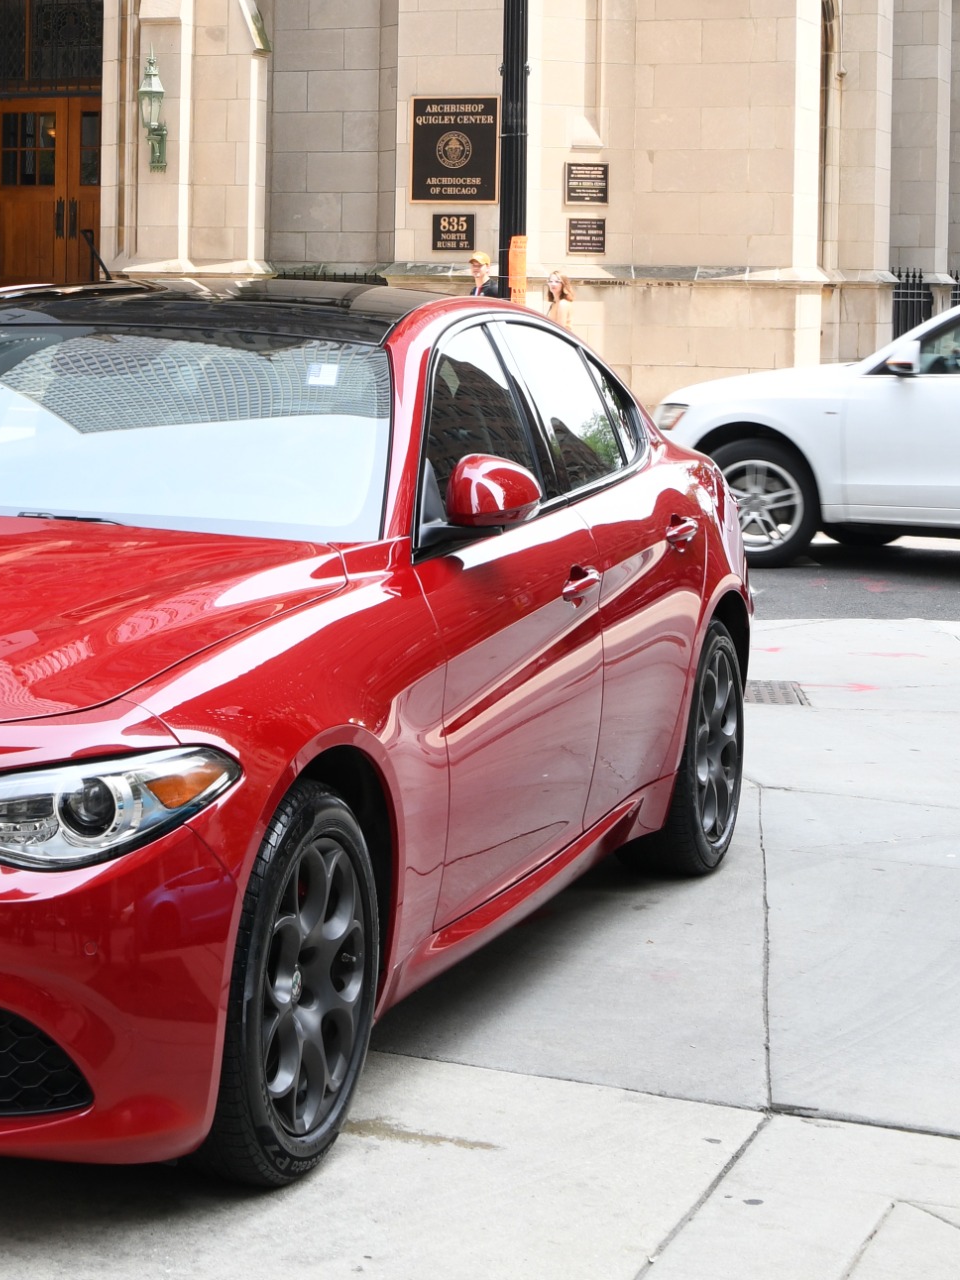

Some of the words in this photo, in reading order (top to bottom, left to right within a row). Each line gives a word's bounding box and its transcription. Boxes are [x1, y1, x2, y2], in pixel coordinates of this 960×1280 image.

[425, 104, 484, 113] ARCHBISHOP
[416, 115, 455, 125] QUIGLEY
[457, 115, 494, 124] CENTER
[426, 177, 482, 185] ARCHDIOCESE
[430, 187, 441, 195] OF
[442, 187, 477, 195] CHICAGO
[440, 216, 467, 232] 835
